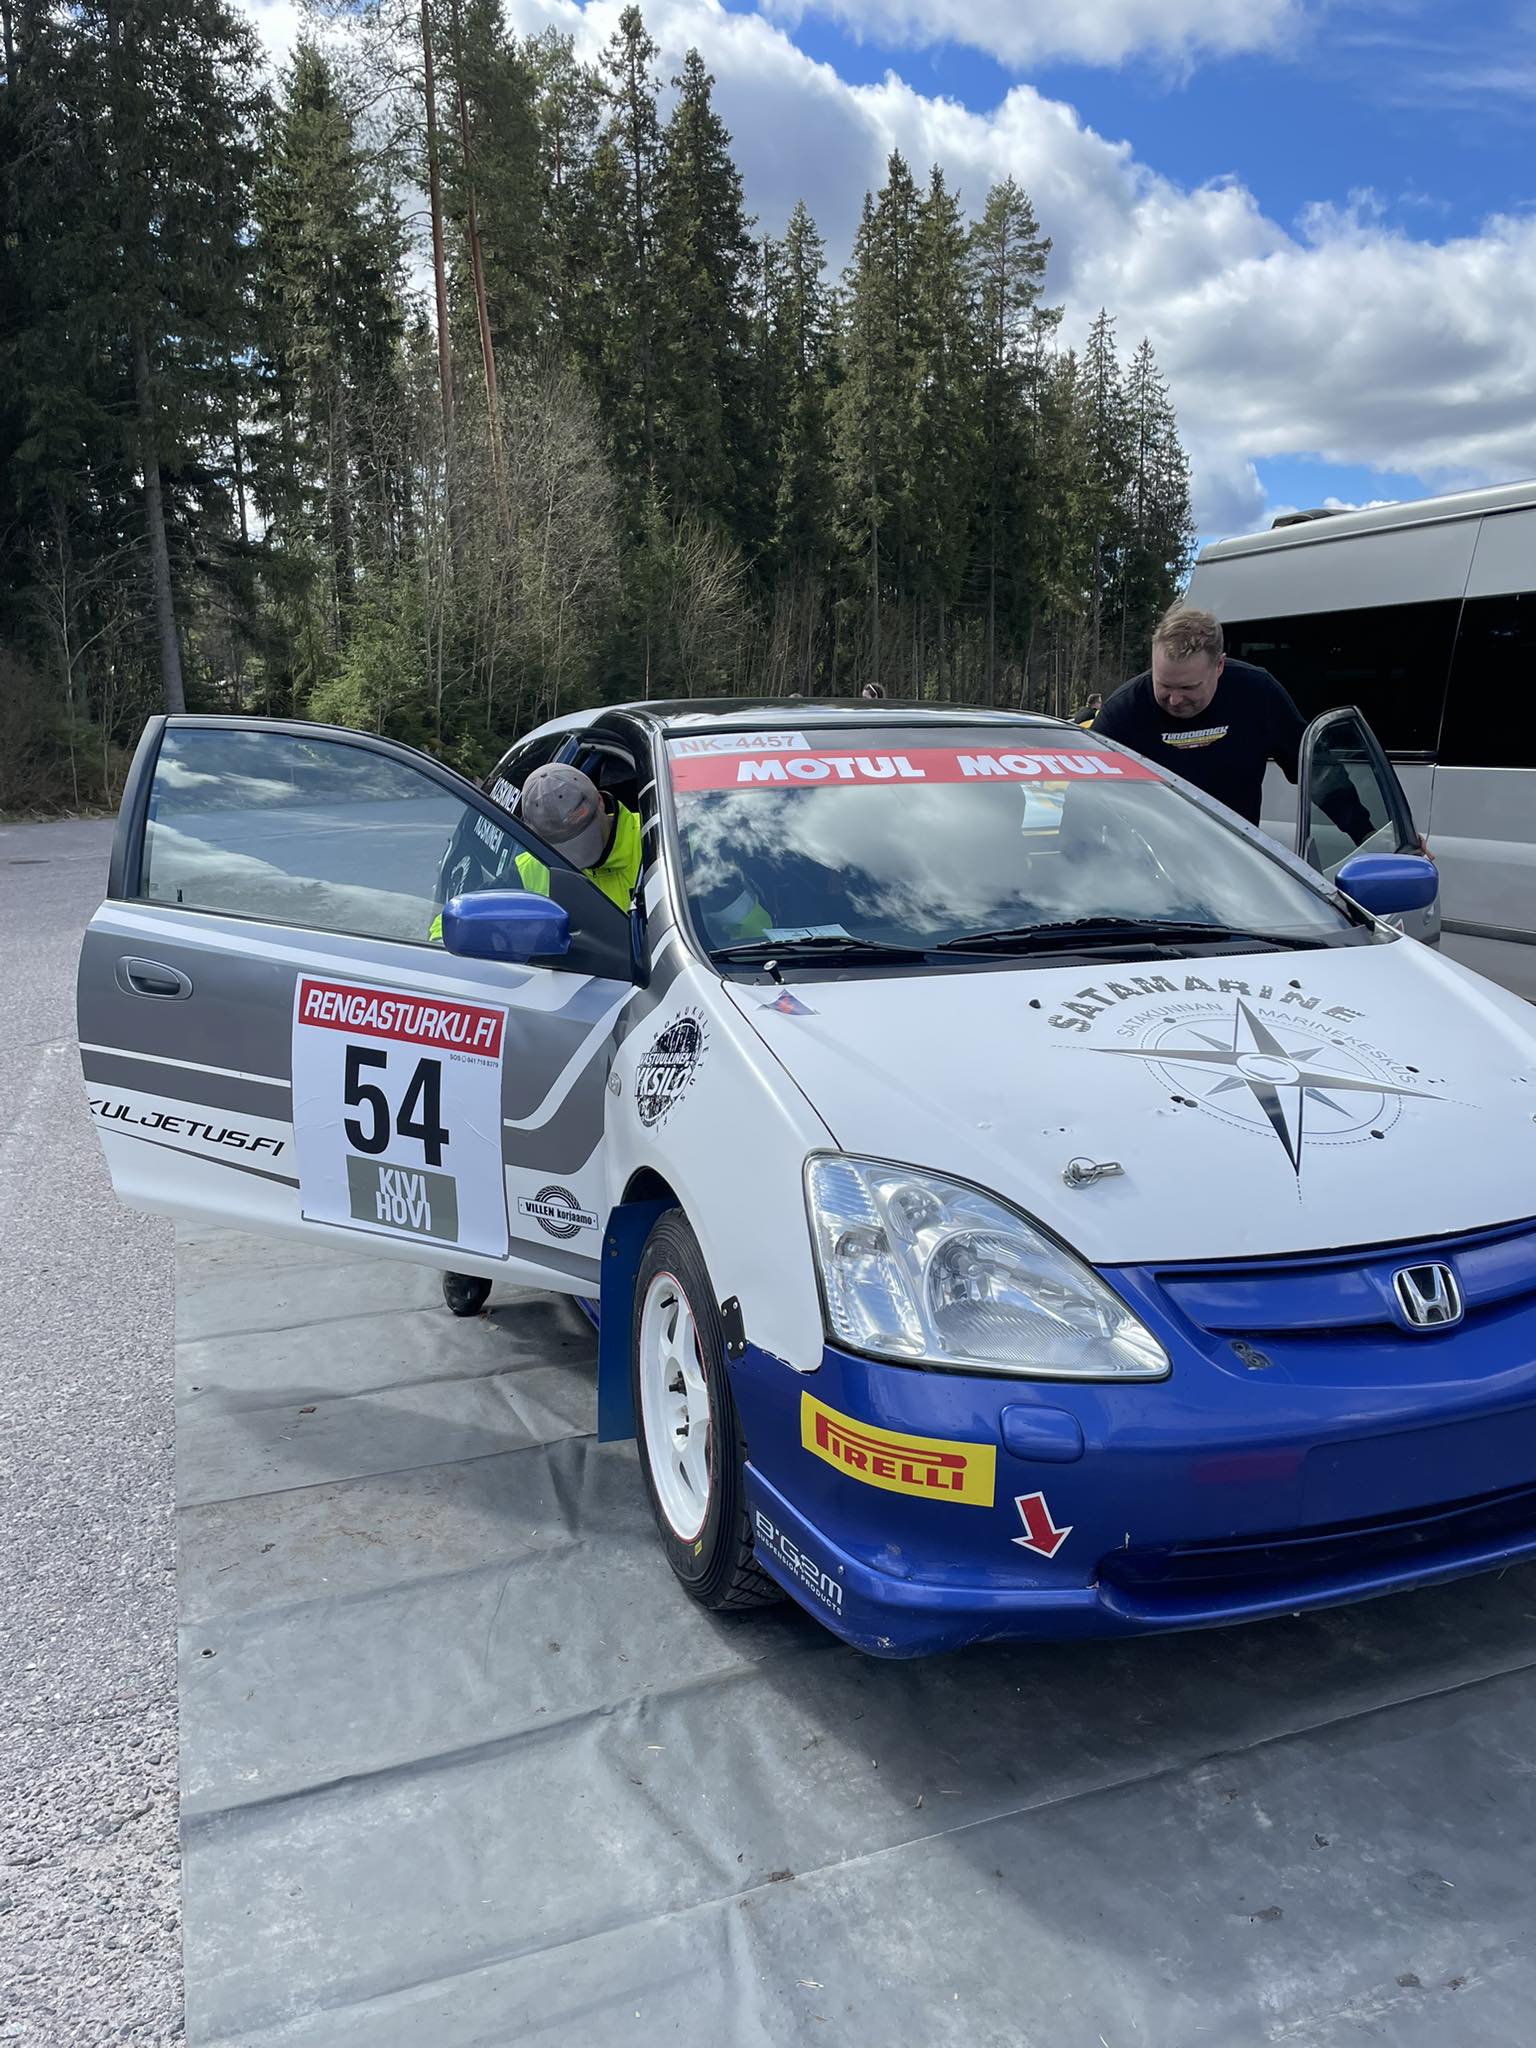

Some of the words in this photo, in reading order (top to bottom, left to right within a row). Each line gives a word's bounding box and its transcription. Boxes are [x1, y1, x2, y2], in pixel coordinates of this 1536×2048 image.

[680, 735, 795, 753] NK-4457
[737, 757, 926, 782] MOTUL
[957, 754, 1124, 777] MOTUL
[304, 988, 497, 1049] RENGASTURKU.FI
[1047, 975, 1366, 1033] SATAMARINE
[1116, 1002, 1224, 1038] SATAKUNNAN
[1258, 1007, 1417, 1084] MARINEKESKUS
[344, 1044, 450, 1168] 54
[376, 1191, 432, 1231] HOVI
[379, 1166, 427, 1204] KIVI
[525, 1201, 554, 1217] VILLEN
[557, 1208, 593, 1225] korjaamo
[816, 1411, 968, 1492] PIRELLI
[756, 1530, 799, 1577] SUSPENSION
[800, 1573, 842, 1616] PRODUCTS
